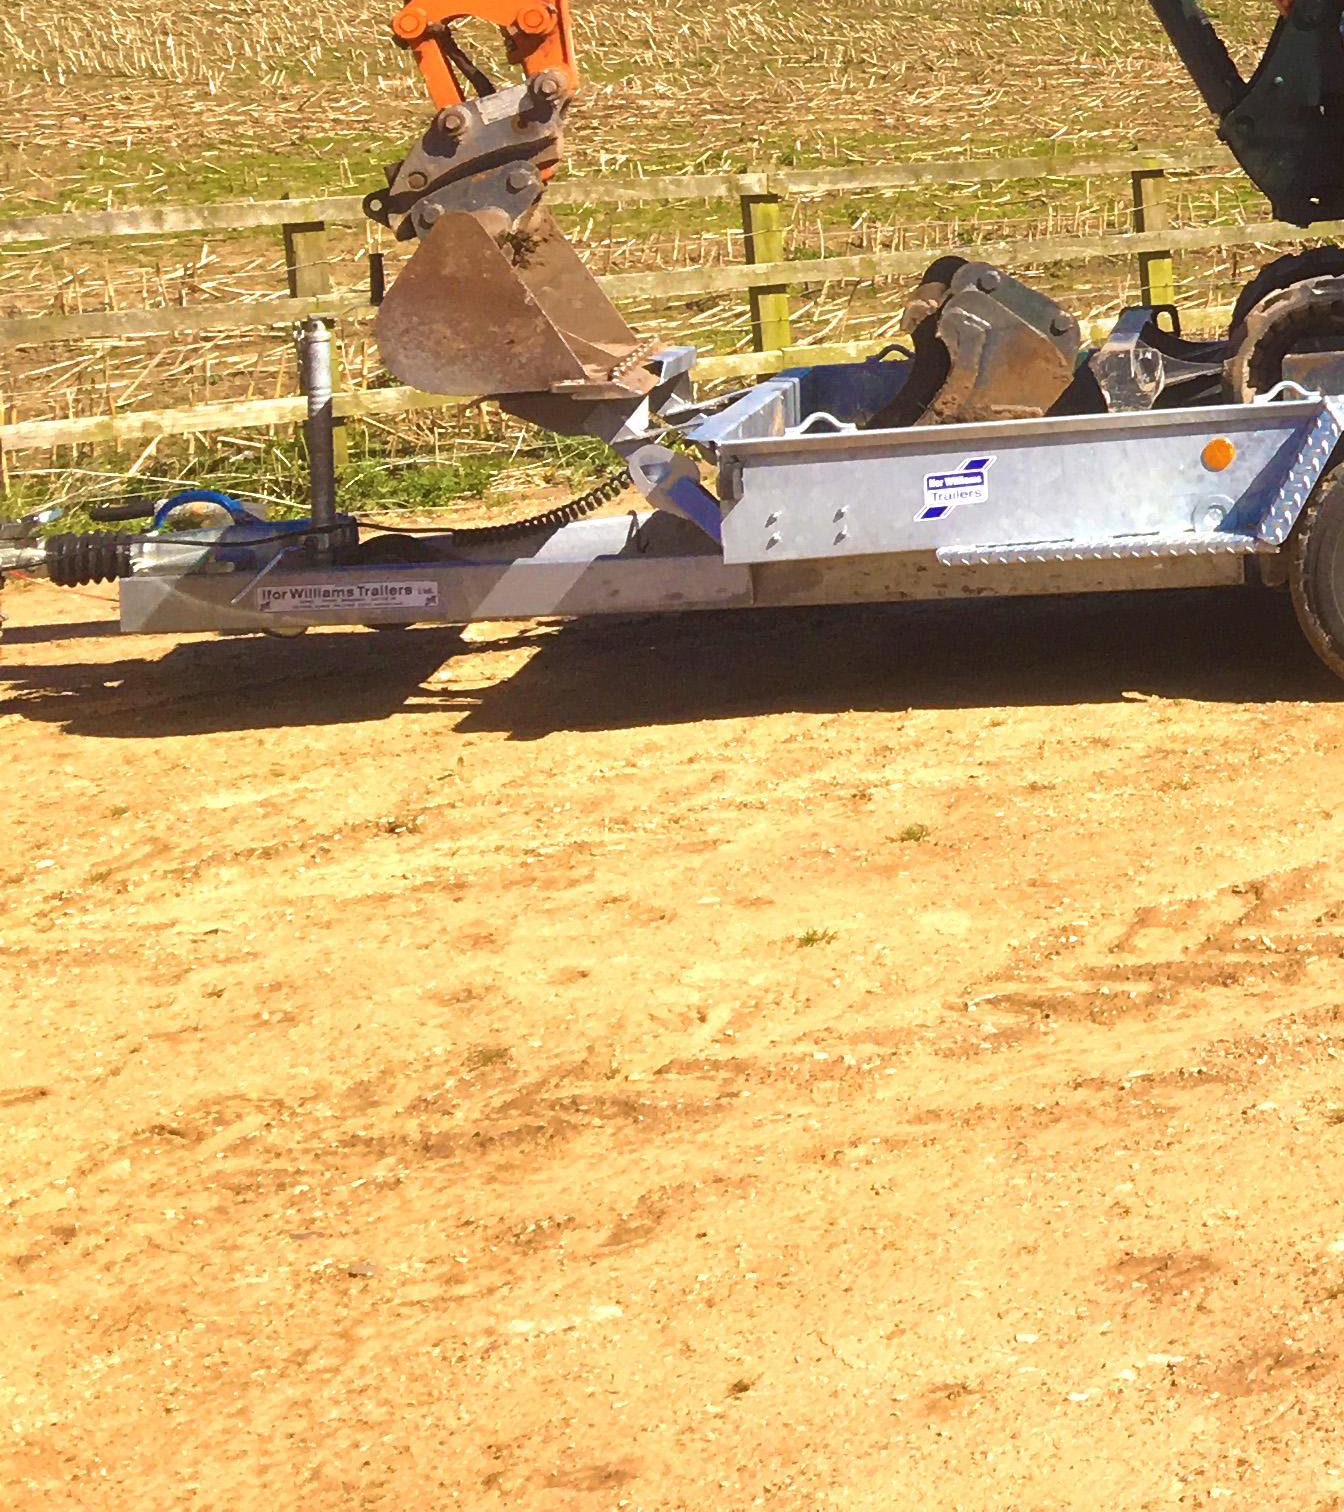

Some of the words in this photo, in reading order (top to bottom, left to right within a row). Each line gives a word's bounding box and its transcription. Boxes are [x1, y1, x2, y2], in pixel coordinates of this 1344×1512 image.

[932, 489, 982, 501] Trailers
[262, 589, 288, 600] Ifor
[289, 586, 355, 600] Williams
[357, 584, 413, 597] Trailers
